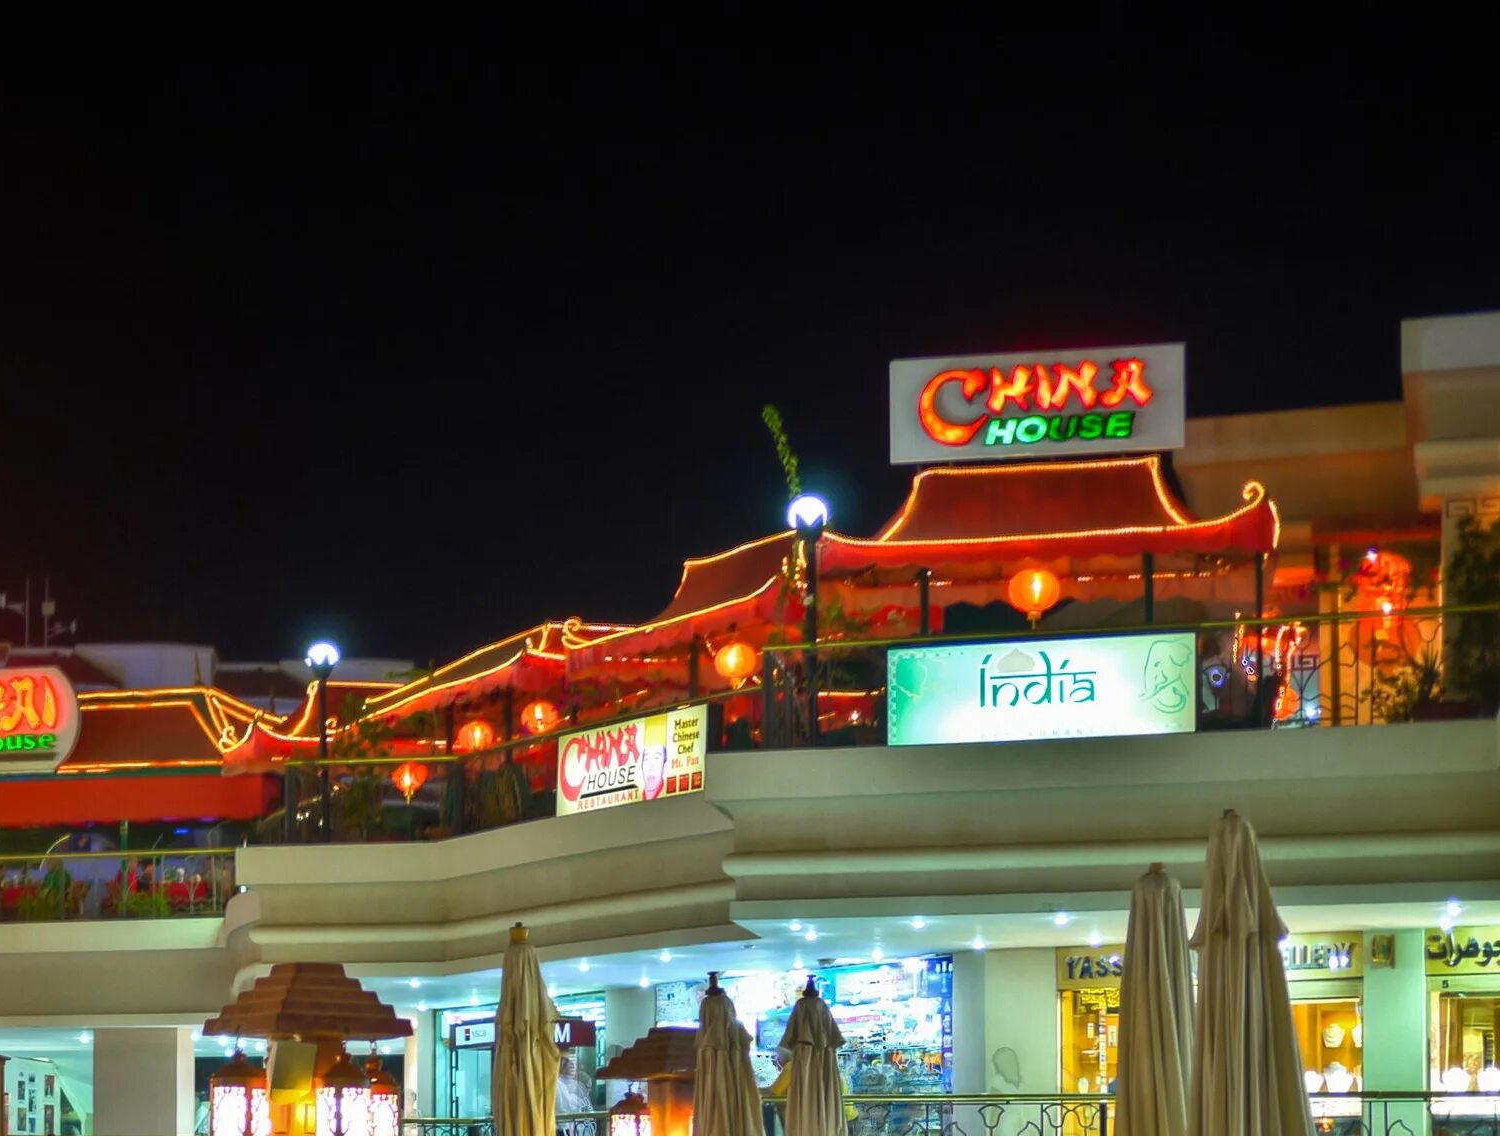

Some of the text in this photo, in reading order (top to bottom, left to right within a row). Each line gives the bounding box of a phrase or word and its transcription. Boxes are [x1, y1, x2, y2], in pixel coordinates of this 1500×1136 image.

[917, 357, 1153, 447] CHINA
[983, 410, 1135, 447] HOUSE
[979, 650, 1097, 708] India
[672, 730, 700, 743] Chinese
[674, 718, 699, 731] Master
[677, 742, 695, 755] Chef
[560, 723, 640, 802] CHINA
[586, 765, 636, 792] HOUSE
[577, 789, 639, 810] RESTAURANT
[1064, 955, 1123, 979] YASS
